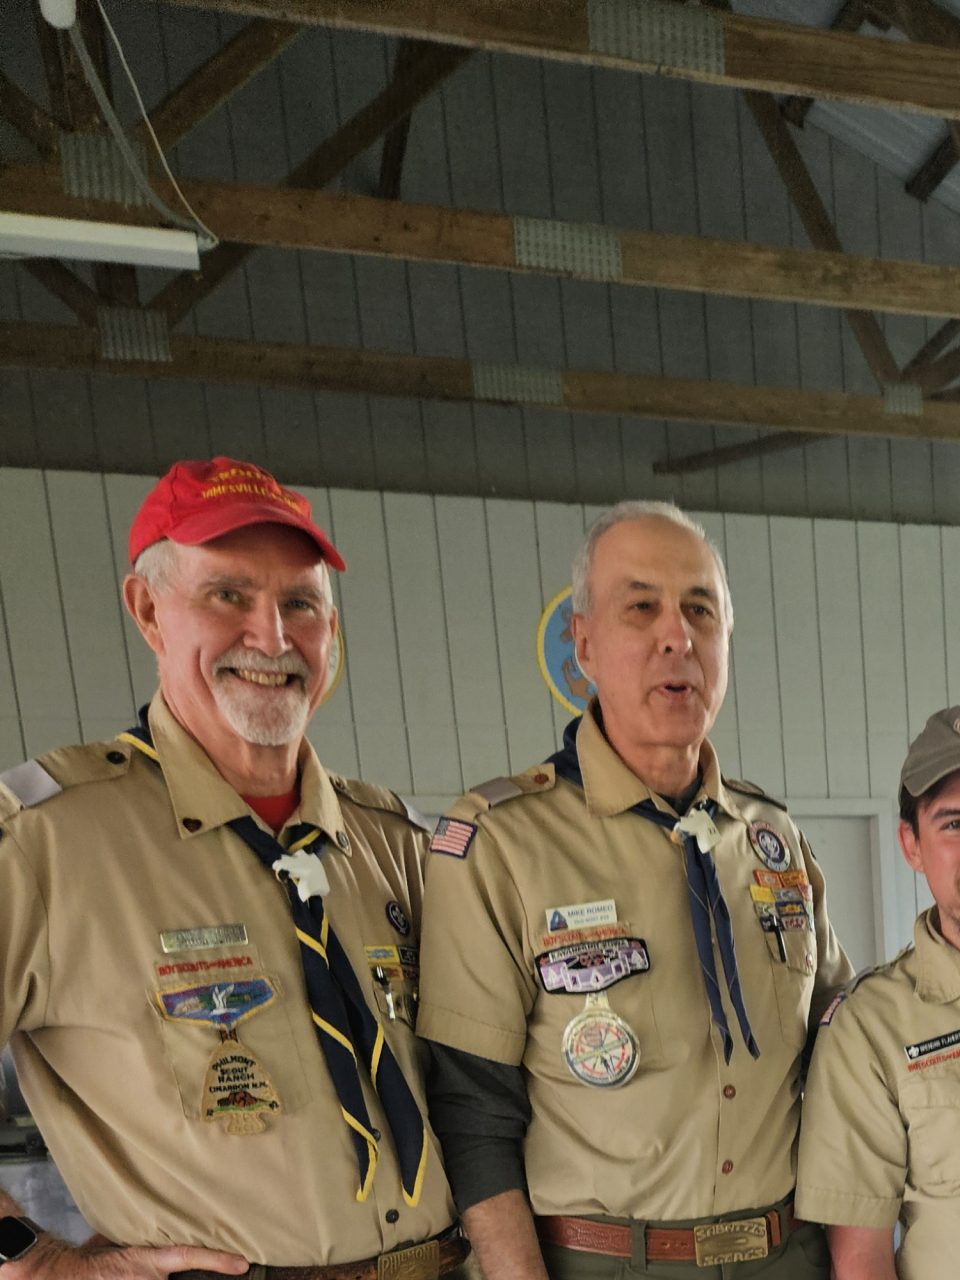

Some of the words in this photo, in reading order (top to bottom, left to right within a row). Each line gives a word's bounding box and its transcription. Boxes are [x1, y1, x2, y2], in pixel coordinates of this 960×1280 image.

[212, 1055, 256, 1072] PHILMONT
[220, 1067, 248, 1075] SCOUT
[218, 1073, 255, 1083] RANCH
